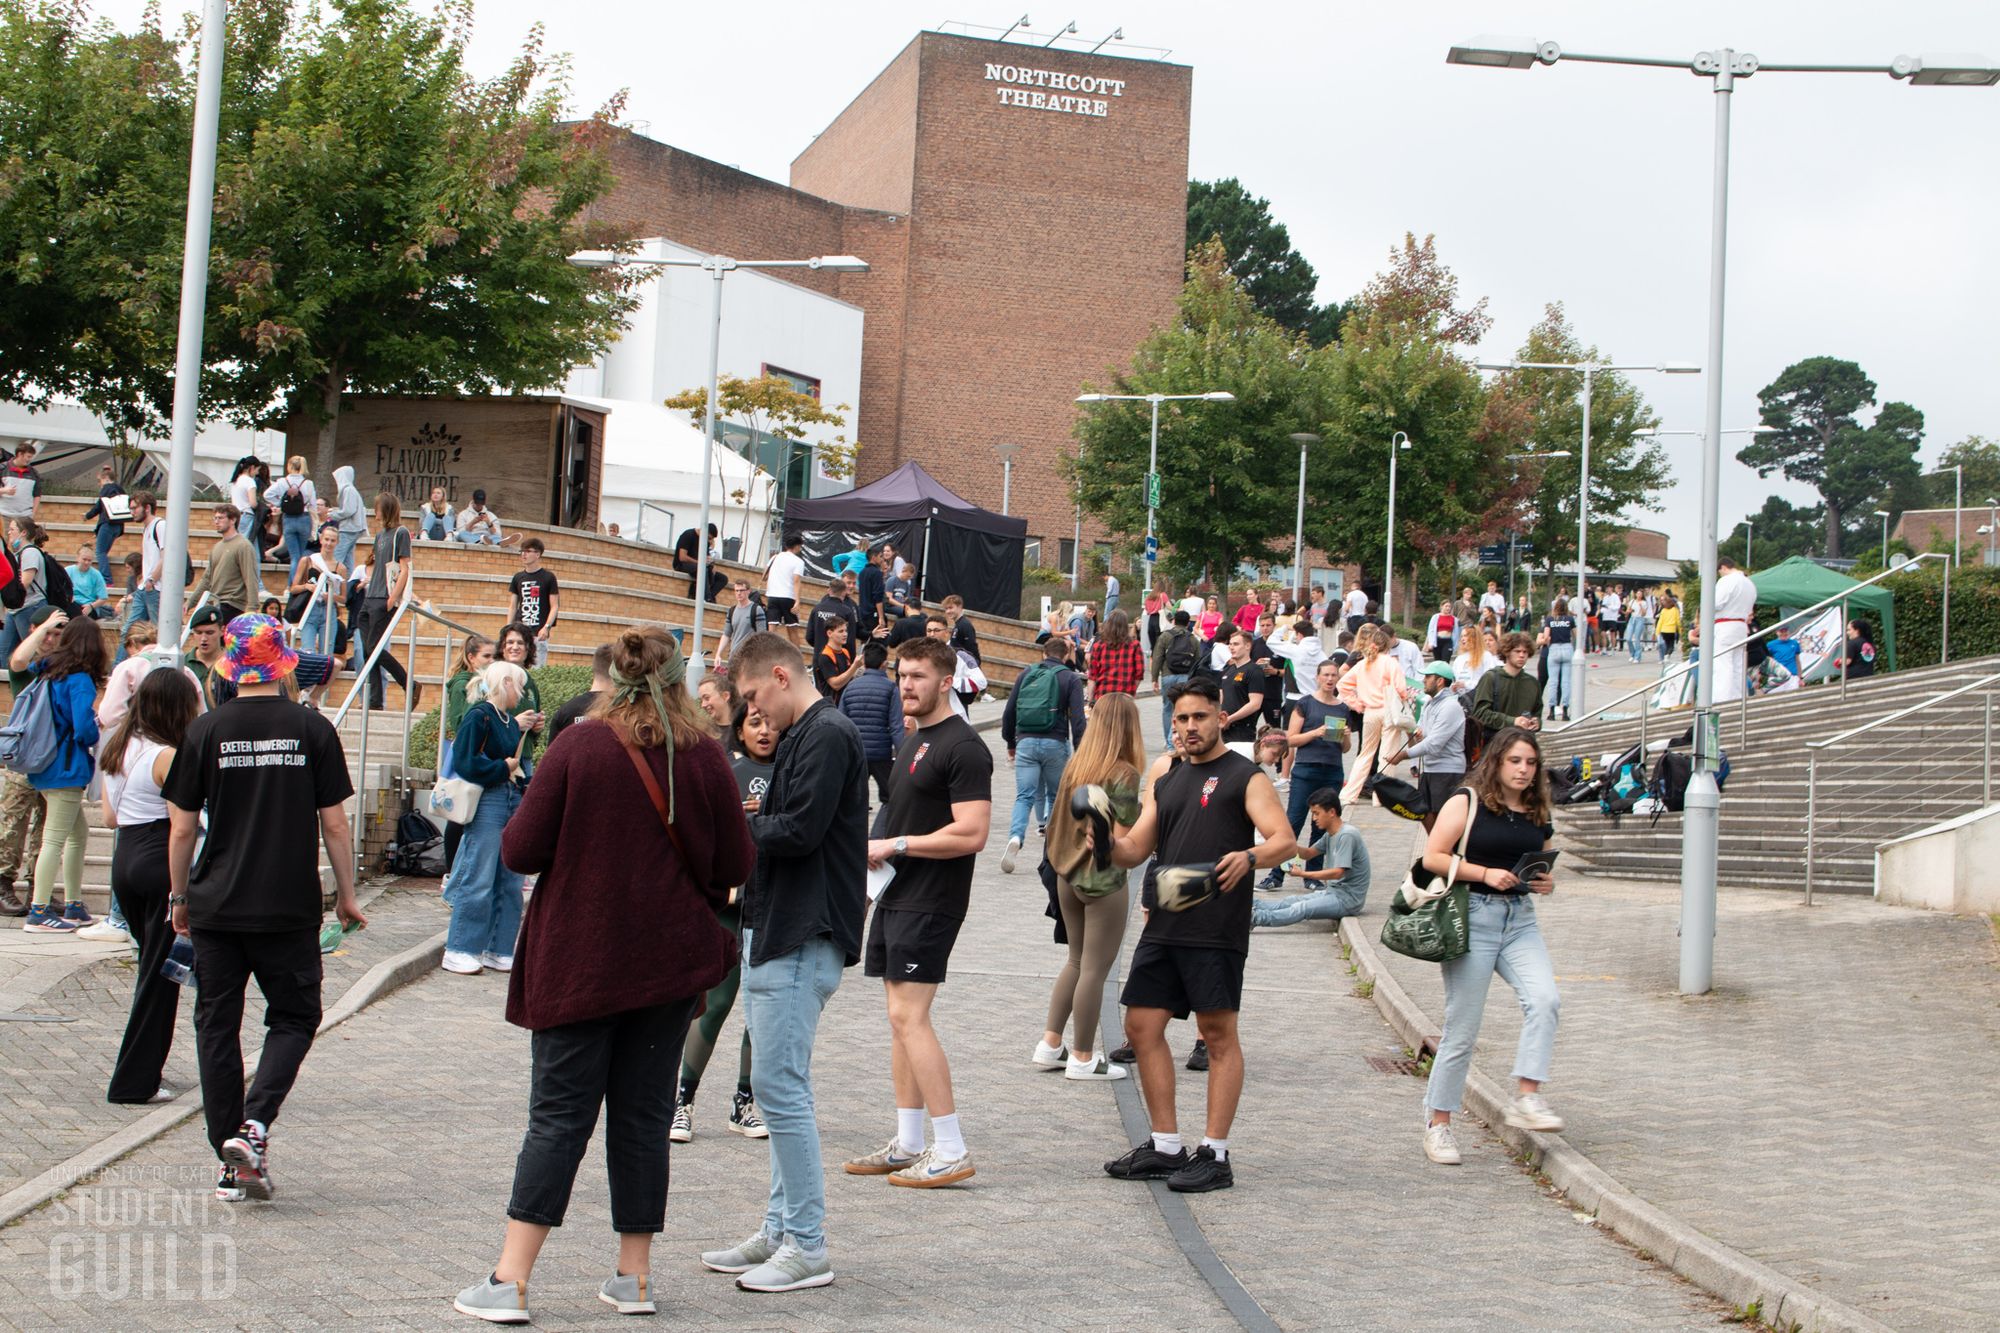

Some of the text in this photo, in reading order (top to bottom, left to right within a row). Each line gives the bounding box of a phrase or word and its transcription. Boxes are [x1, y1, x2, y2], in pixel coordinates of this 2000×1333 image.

[984, 63, 1125, 97] NORTHCOTT
[997, 87, 1108, 117] THEATRE
[375, 444, 447, 475] FLAVOUR
[521, 581, 531, 623] NORTH
[530, 596, 540, 626] FACE
[1550, 620, 1570, 628] EURC
[220, 739, 300, 753] EXETER UNIVERSITY
[218, 754, 306, 769] AMATEUR BOXING CLUB
